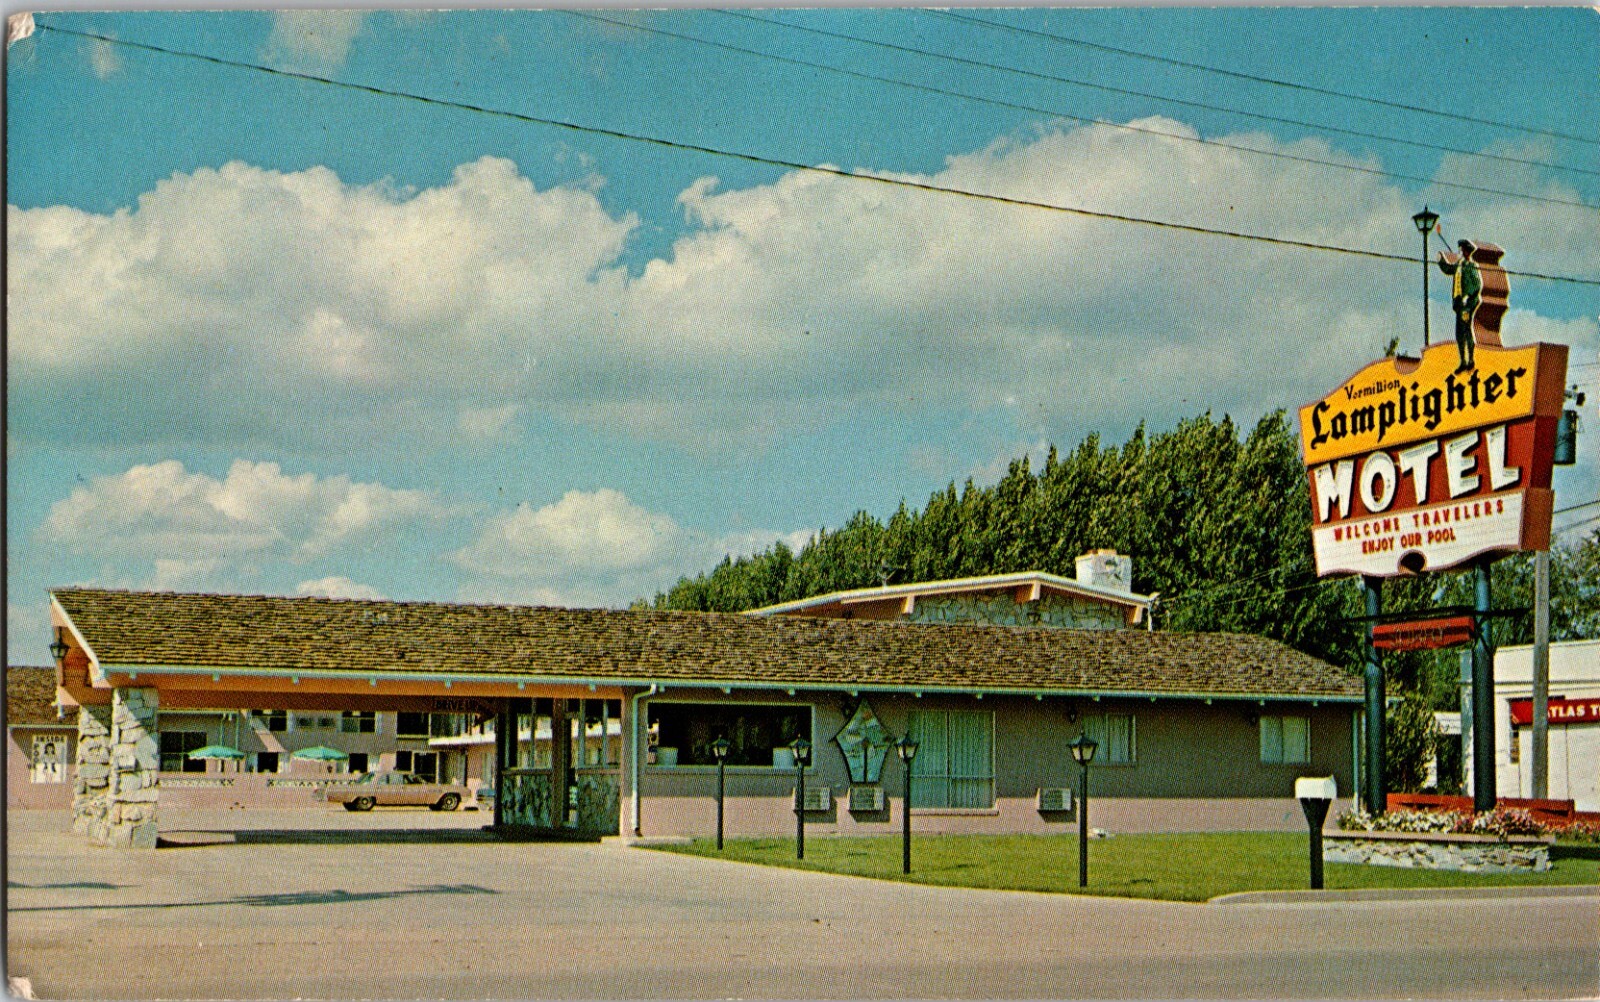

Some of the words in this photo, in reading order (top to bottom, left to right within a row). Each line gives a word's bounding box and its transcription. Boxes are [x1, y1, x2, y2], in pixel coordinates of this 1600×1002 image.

[1310, 366, 1527, 449] Lamplighter
[1313, 423, 1520, 524] MOTEL
[1334, 517, 1400, 541] WELCOME
[1412, 499, 1504, 528] TRAVELERS
[1362, 537, 1394, 554] ENJOY
[1400, 532, 1422, 548] OUR
[1427, 527, 1456, 545] POOL
